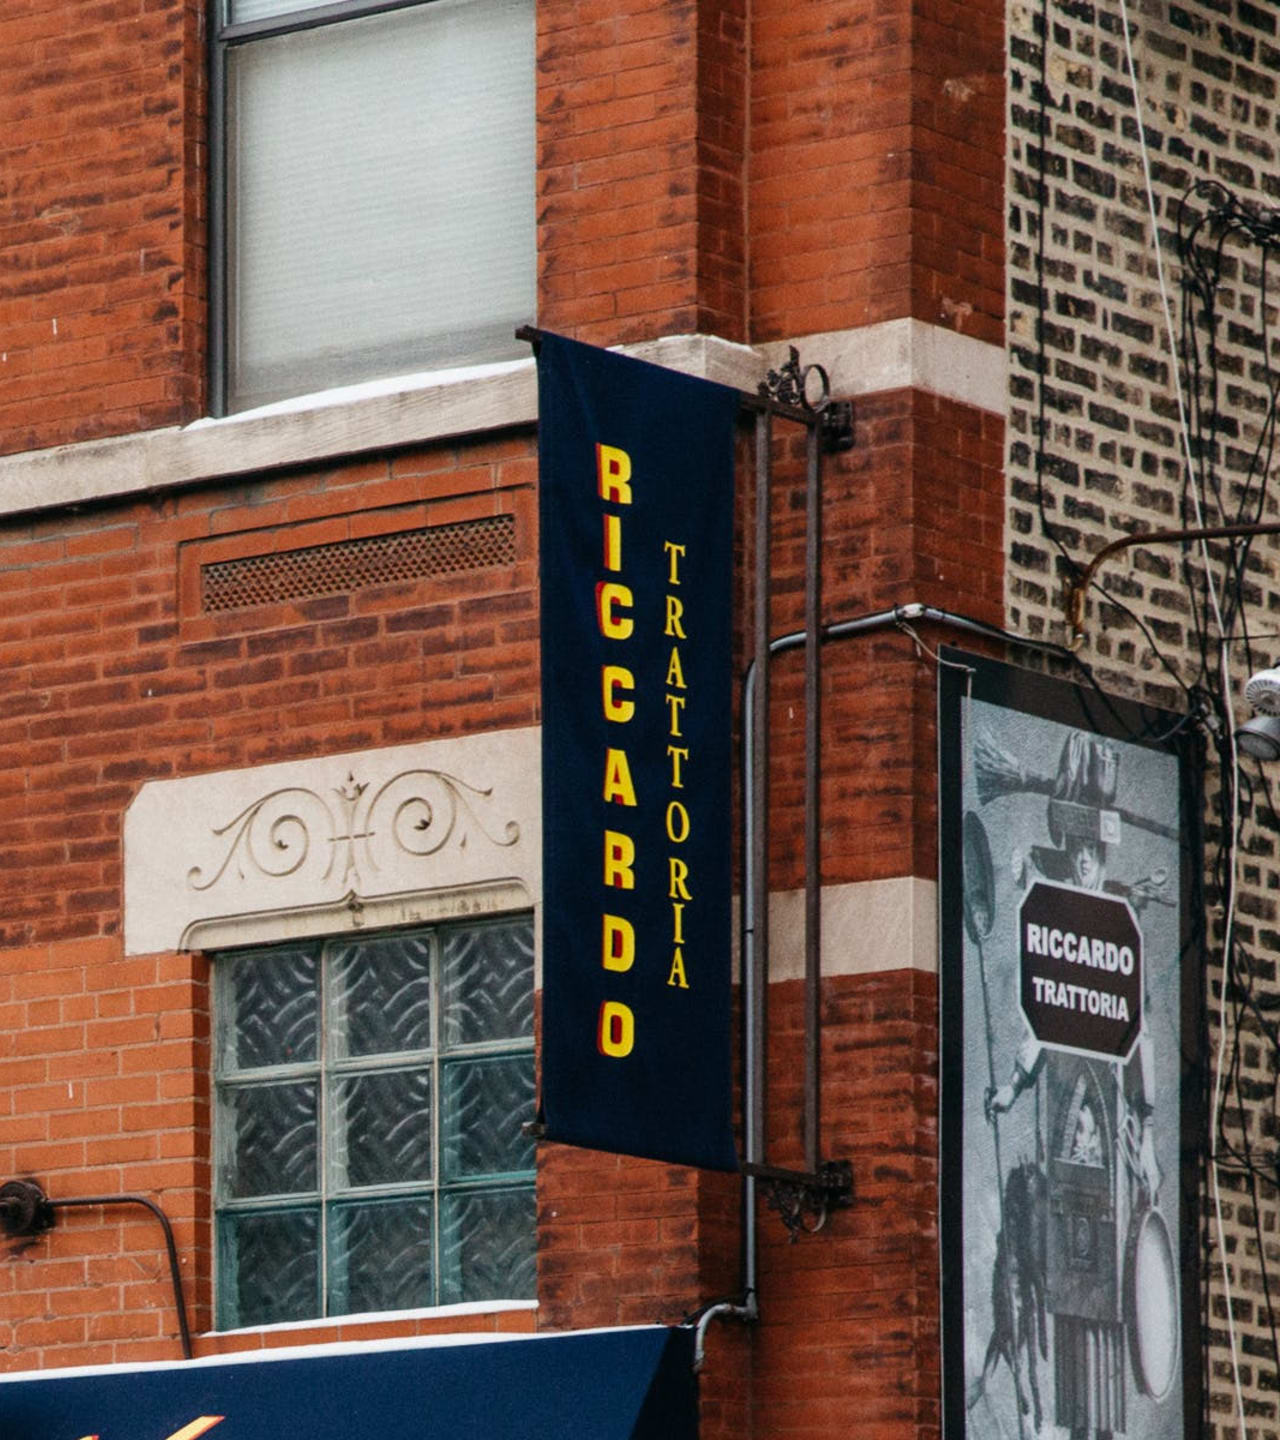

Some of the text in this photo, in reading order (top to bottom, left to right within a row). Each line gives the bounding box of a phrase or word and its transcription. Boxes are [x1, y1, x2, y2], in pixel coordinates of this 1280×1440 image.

[595, 443, 638, 1058] RICCARDO
[663, 541, 692, 989] TRATTORIA
[1027, 923, 1135, 976] RICCARDO
[1032, 976, 1130, 1023] TRATTORIA
